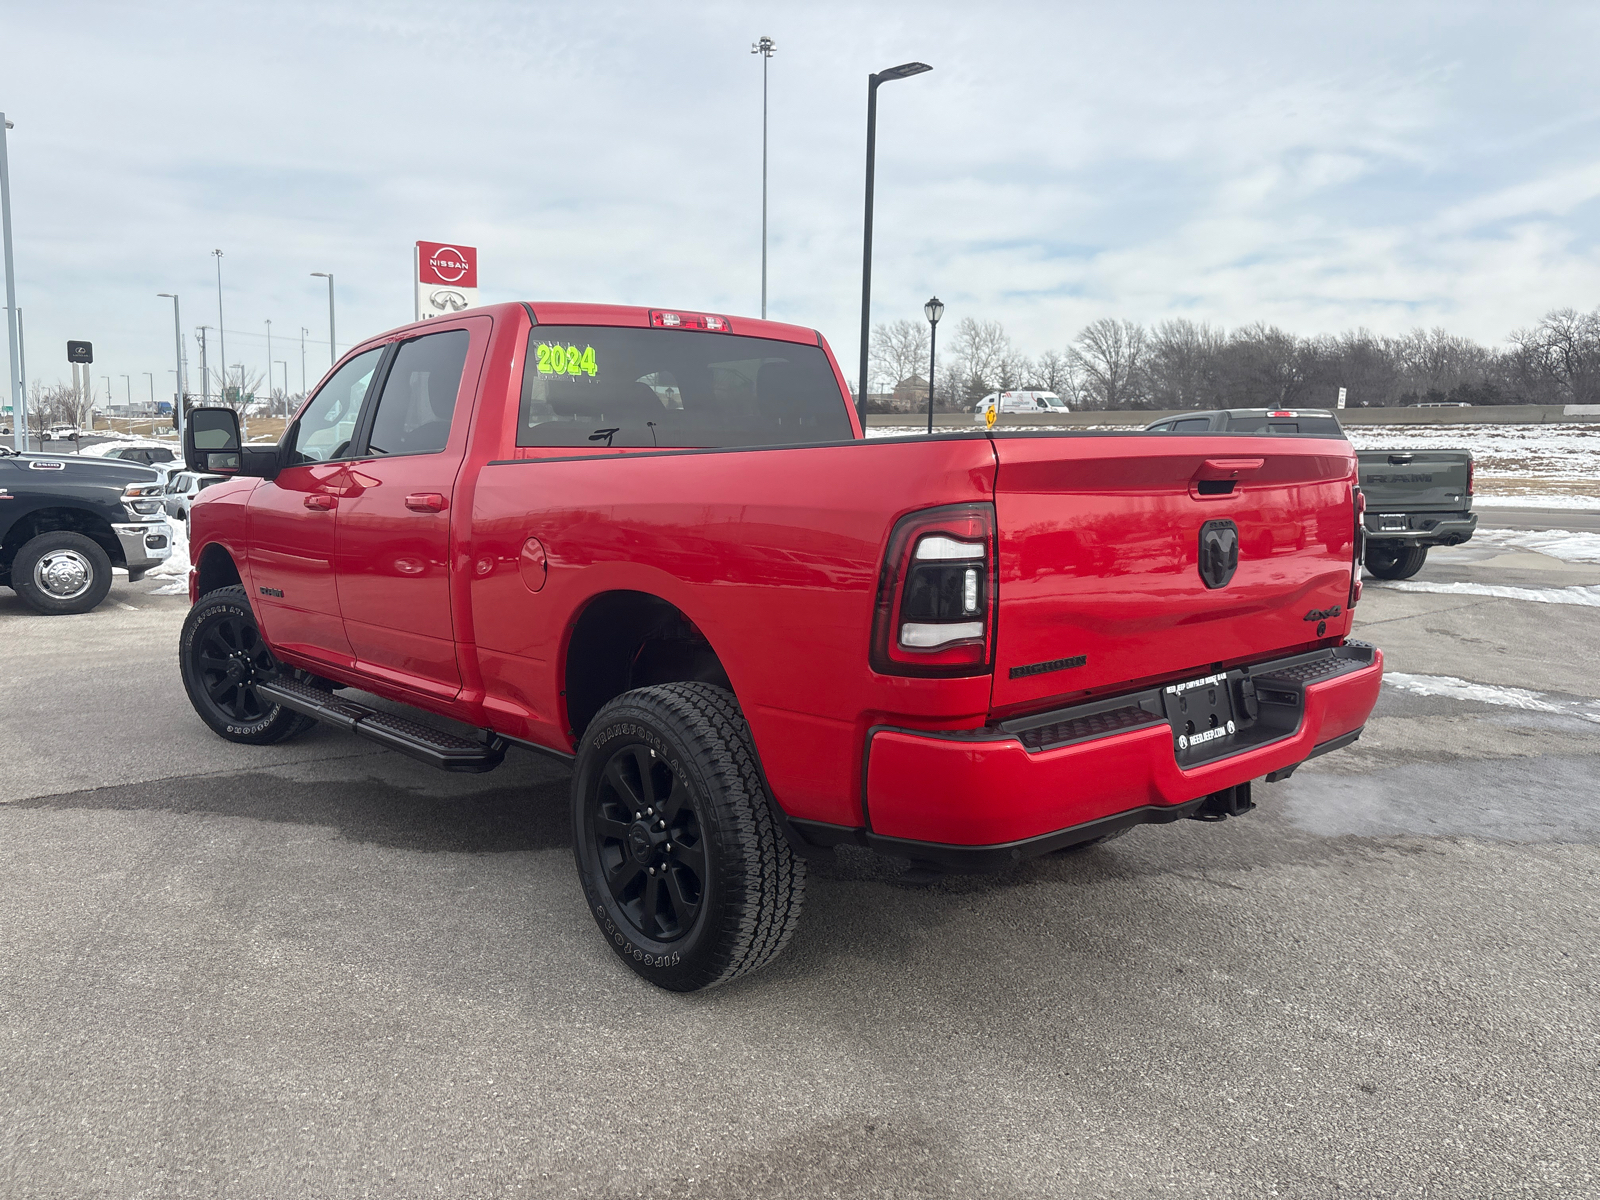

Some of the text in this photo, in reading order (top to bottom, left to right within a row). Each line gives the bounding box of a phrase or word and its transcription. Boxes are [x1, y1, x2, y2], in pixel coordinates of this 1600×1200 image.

[430, 259, 469, 270] NISSAN
[537, 344, 597, 376] 2024
[1366, 474, 1433, 483] RAM
[1209, 520, 1232, 529] RAM
[593, 723, 669, 756] TRANSFORCE
